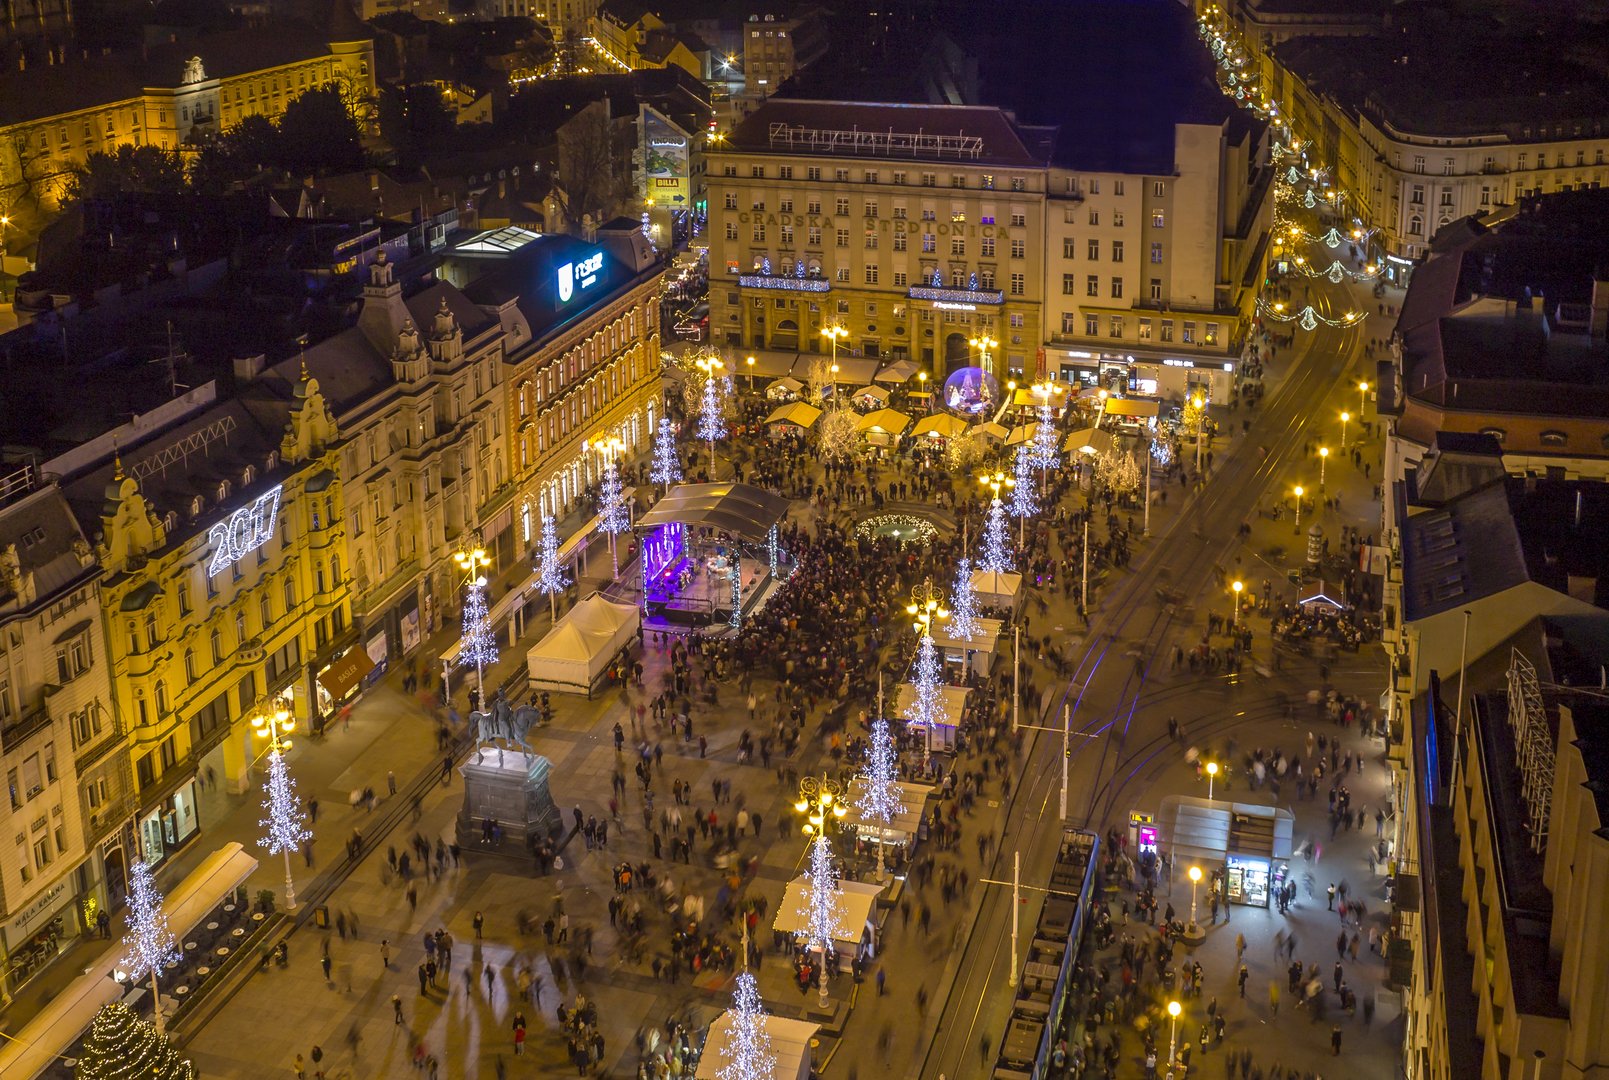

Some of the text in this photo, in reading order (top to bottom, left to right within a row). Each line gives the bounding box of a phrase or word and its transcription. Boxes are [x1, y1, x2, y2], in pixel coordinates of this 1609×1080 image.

[738, 212, 834, 229] GRADSKA
[209, 484, 283, 578] 2017
[337, 664, 358, 684] BASLER
[15, 883, 65, 929] MALA KAVANA
